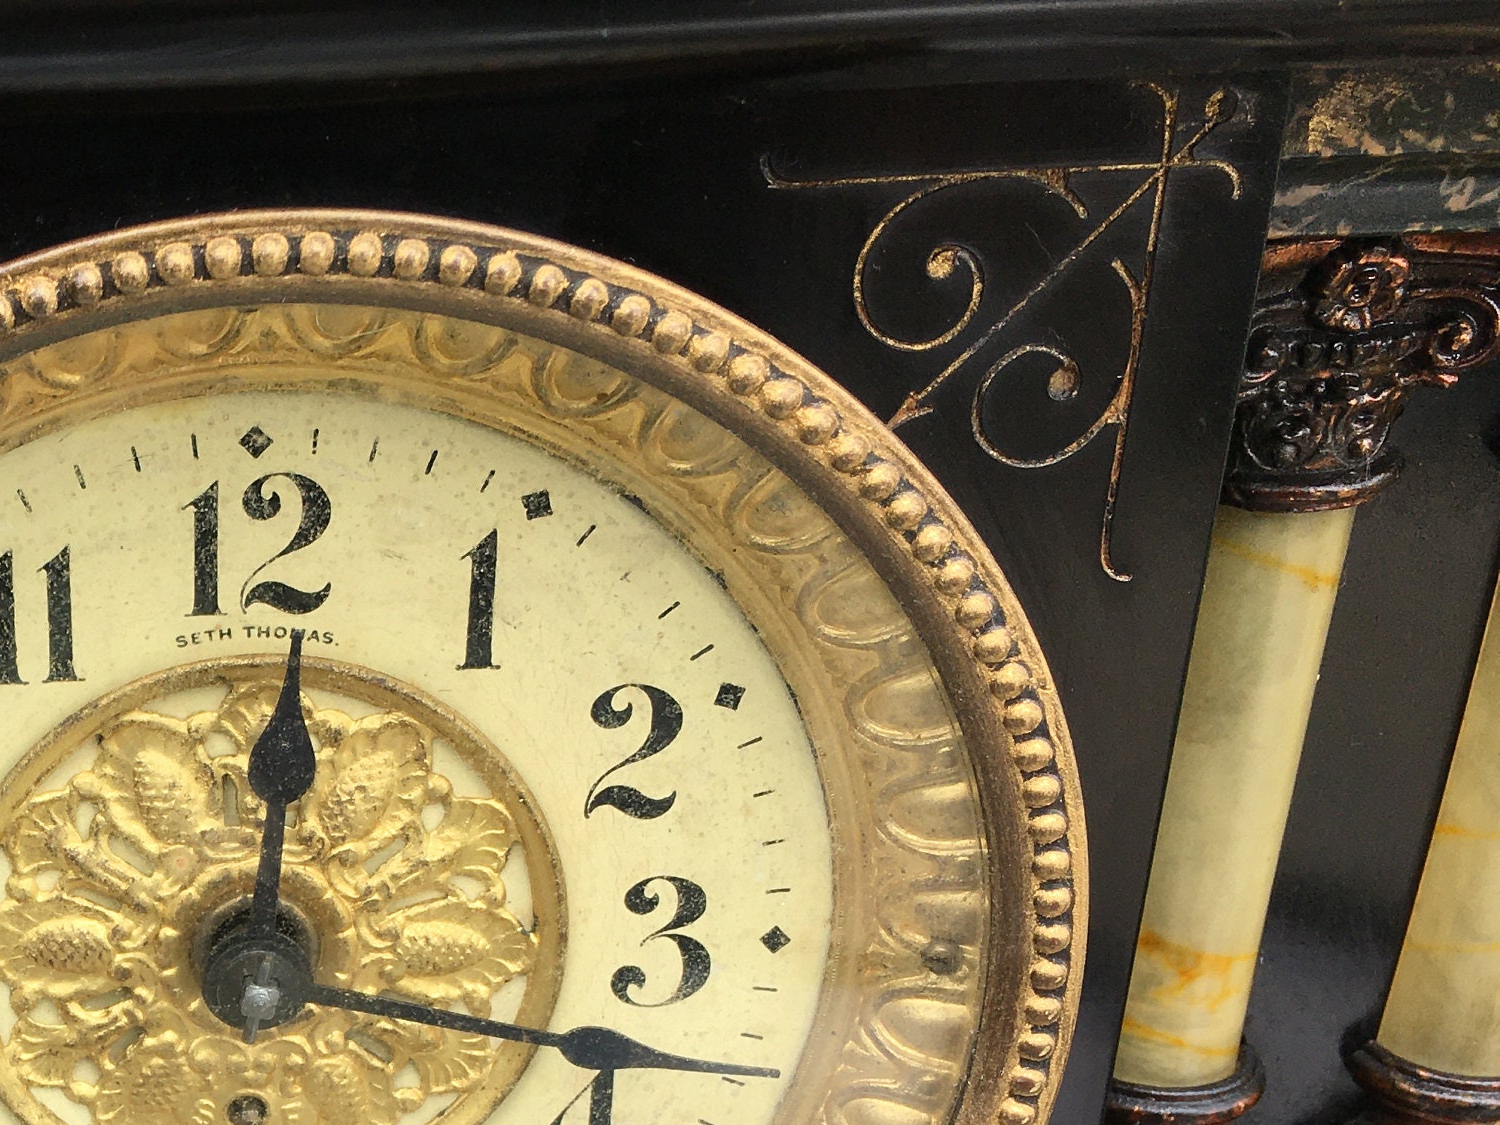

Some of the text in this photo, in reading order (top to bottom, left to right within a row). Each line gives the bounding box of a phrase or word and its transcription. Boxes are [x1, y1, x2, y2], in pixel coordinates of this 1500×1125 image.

[181, 472, 331, 617] 12
[456, 528, 501, 670] 1
[175, 627, 233, 649] SETH
[584, 683, 683, 819] 2
[611, 876, 711, 1006] 3
